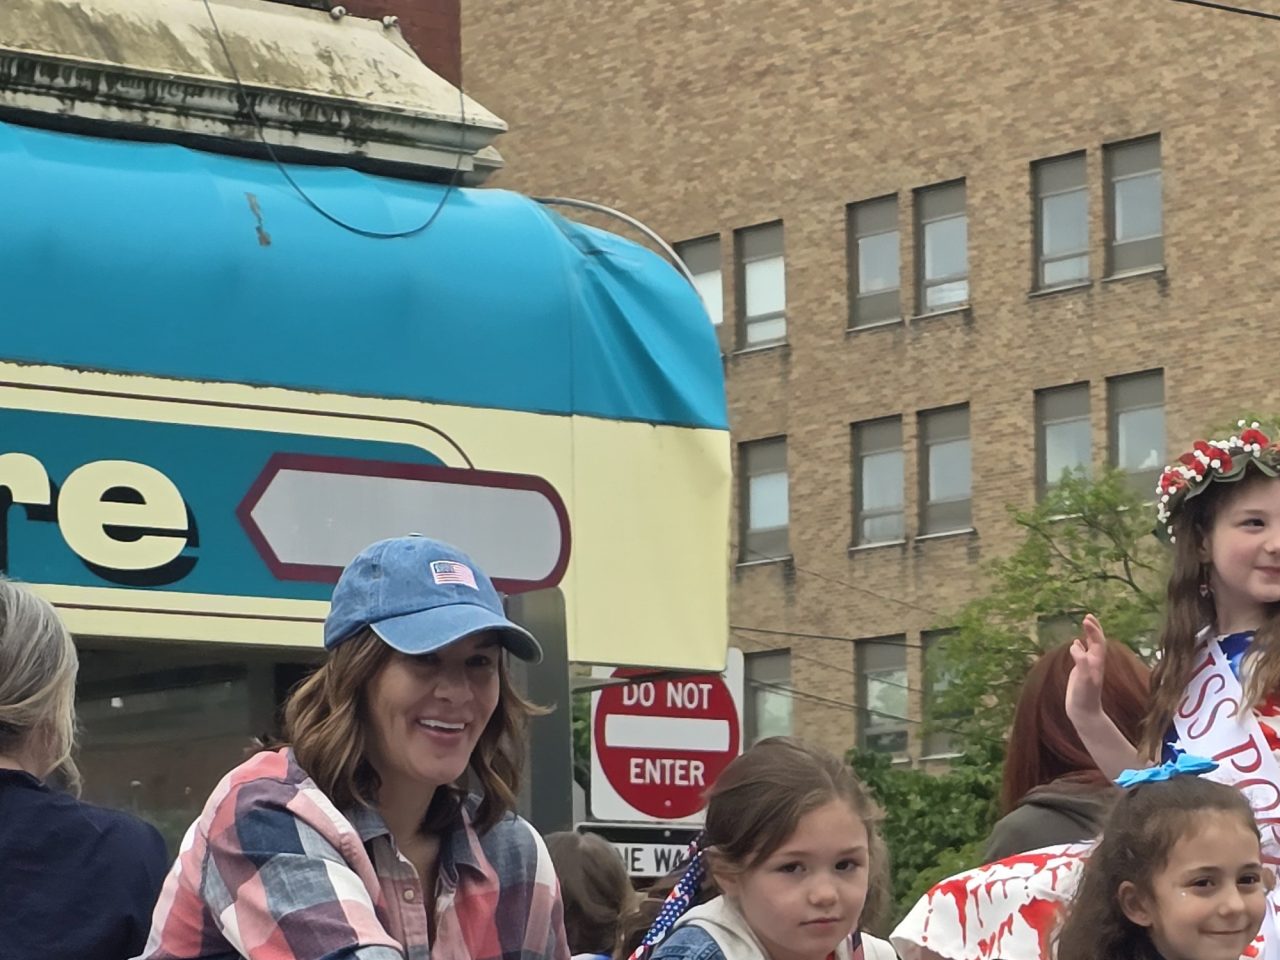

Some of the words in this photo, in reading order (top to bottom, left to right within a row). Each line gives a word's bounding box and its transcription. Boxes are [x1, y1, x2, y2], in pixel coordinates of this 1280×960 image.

[622, 682, 655, 707] DO
[667, 682, 712, 709] NOT
[1179, 642, 1239, 740] ISS
[630, 758, 705, 786] ENTER
